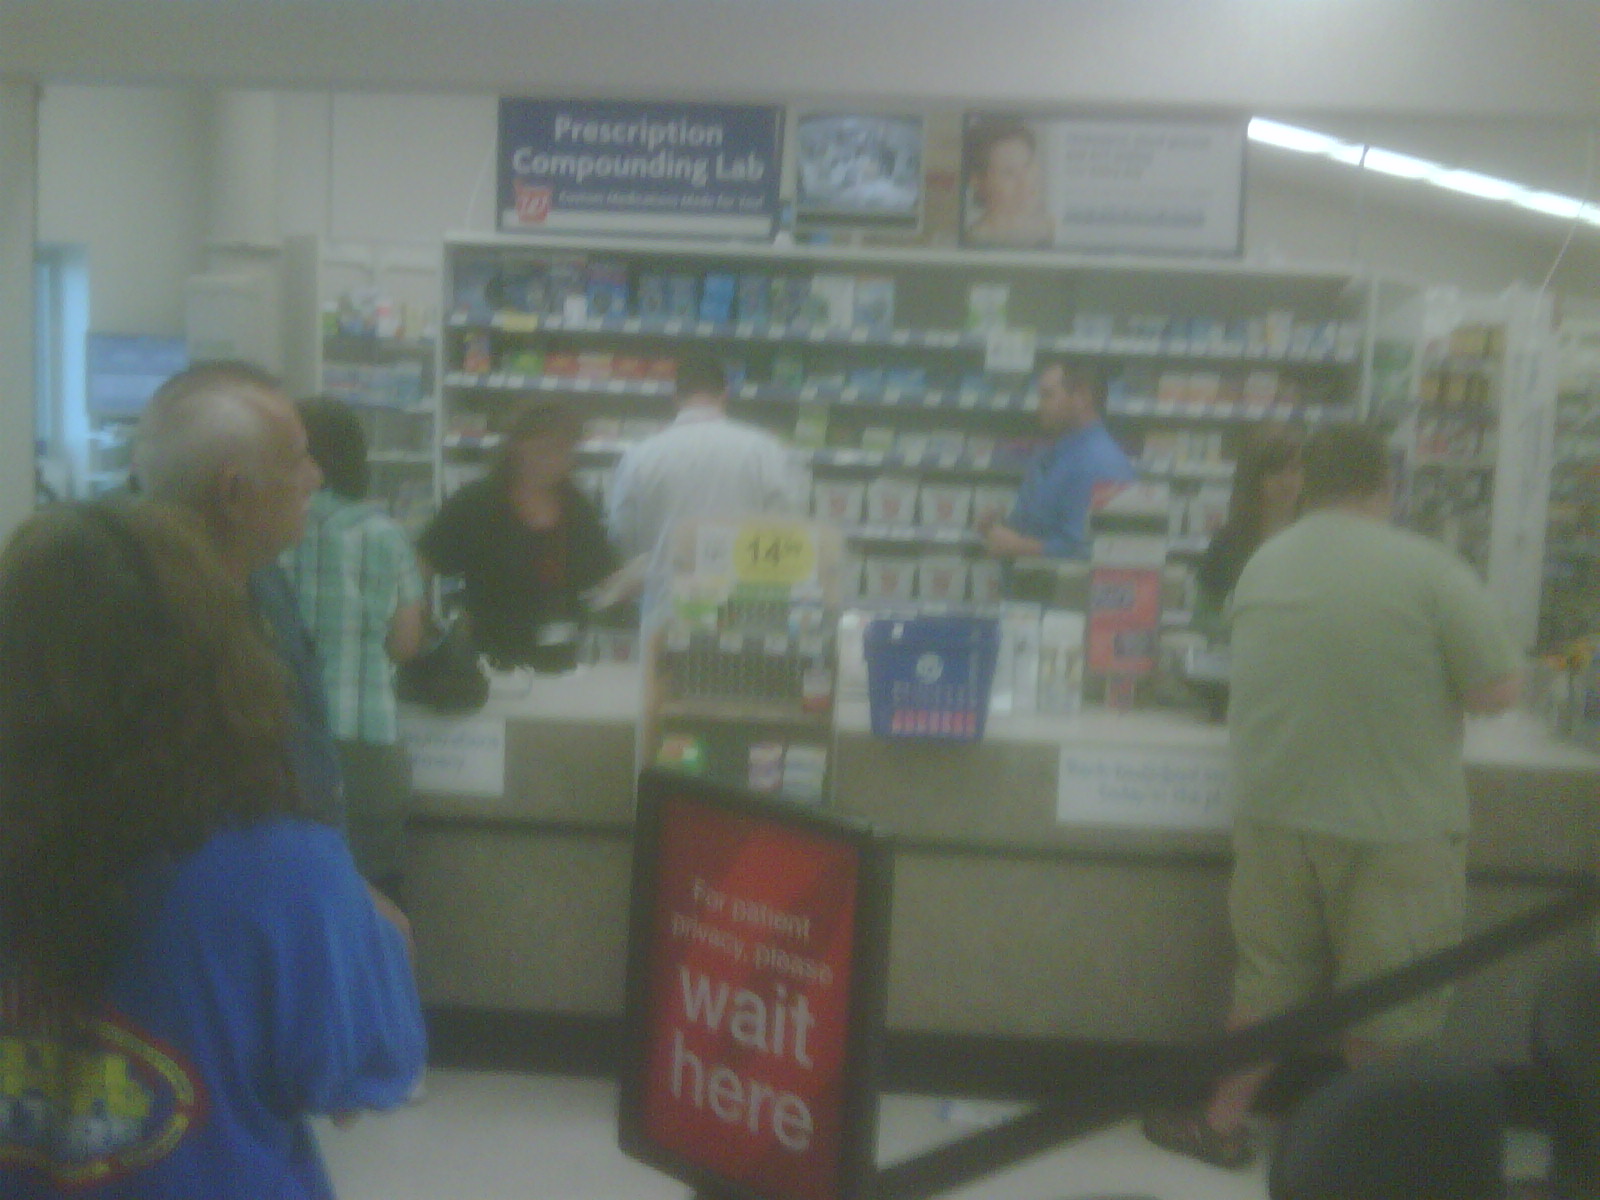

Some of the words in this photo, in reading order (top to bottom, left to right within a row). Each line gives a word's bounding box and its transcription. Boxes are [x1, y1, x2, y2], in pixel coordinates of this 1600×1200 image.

[554, 112, 723, 152] Prescription
[512, 147, 709, 188] Compounding
[715, 151, 765, 181] Lab
[693, 879, 725, 914] For
[732, 899, 811, 941] patient
[755, 942, 834, 985] please
[679, 965, 815, 1070] wait
[672, 1028, 815, 1152] here
